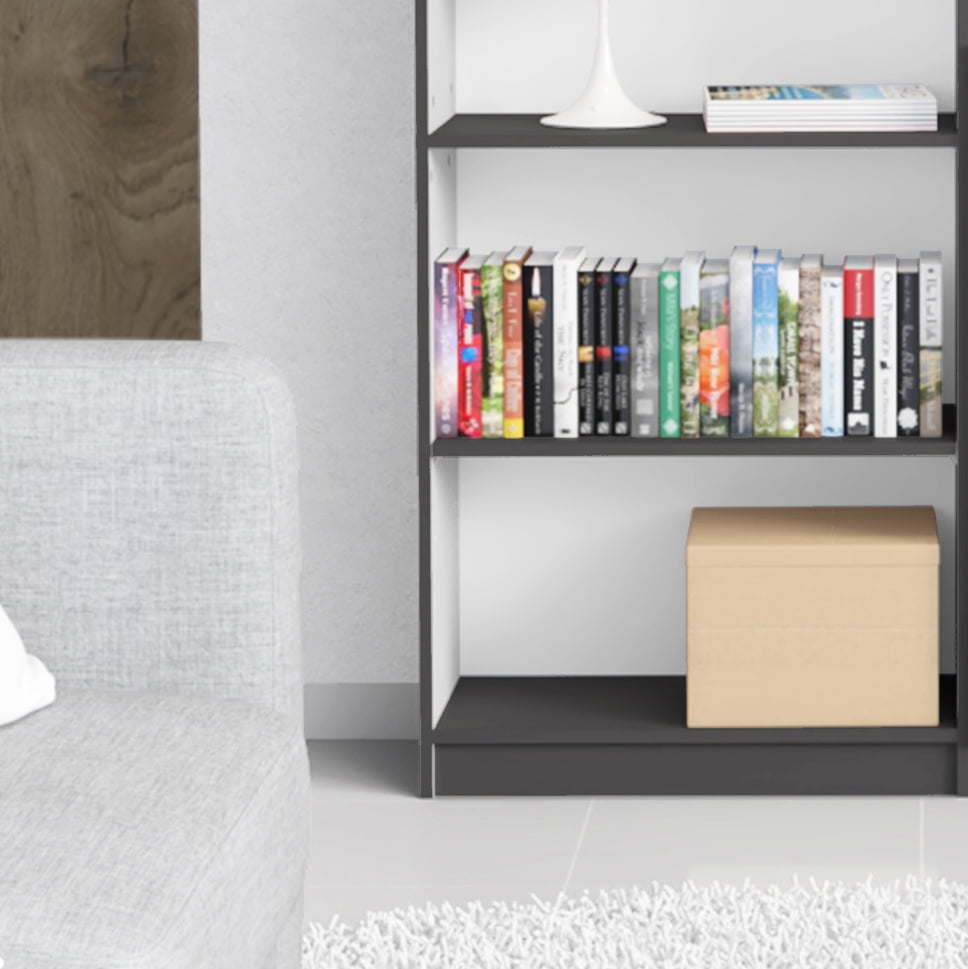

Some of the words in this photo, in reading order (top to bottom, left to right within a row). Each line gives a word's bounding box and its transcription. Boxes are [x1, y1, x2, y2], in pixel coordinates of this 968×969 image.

[880, 272, 893, 300] ONLY
[534, 311, 543, 327] Life
[880, 303, 893, 358] POSSESSION
[534, 328, 543, 339] of
[534, 340, 543, 353] the
[664, 324, 678, 350] Story
[852, 329, 866, 356] Have
[534, 355, 543, 384] Candle
